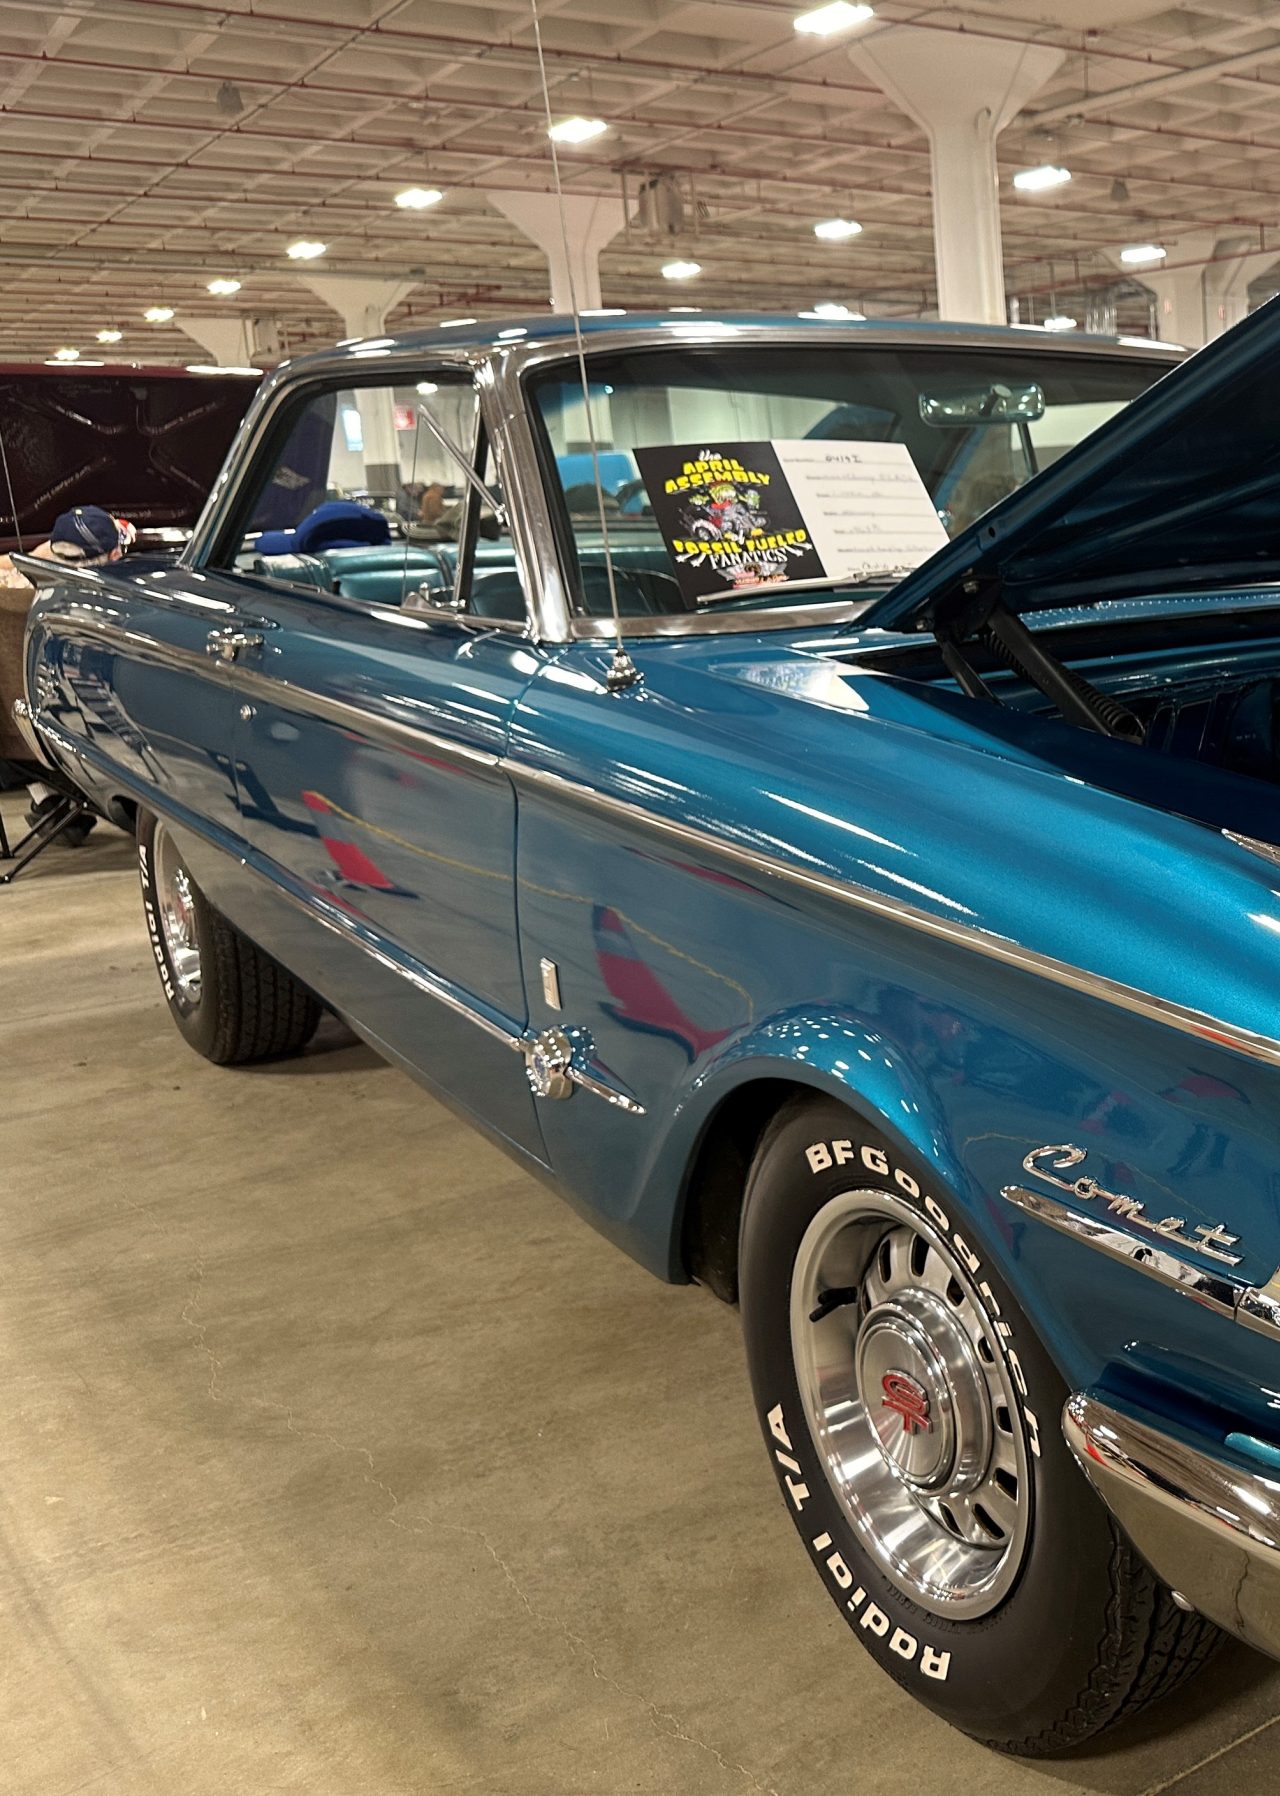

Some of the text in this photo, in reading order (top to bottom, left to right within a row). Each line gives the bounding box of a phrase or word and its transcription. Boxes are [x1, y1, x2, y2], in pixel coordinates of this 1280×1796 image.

[682, 458, 744, 475] APRIL
[698, 449, 722, 461] the
[664, 470, 771, 494] ASSEMBLY
[672, 529, 807, 555] FOSSIL FUELED
[708, 548, 788, 570] FANATICS
[1020, 1143, 1247, 1267] Comet
[766, 1402, 810, 1513] T/A
[812, 1530, 951, 1683] Radial
